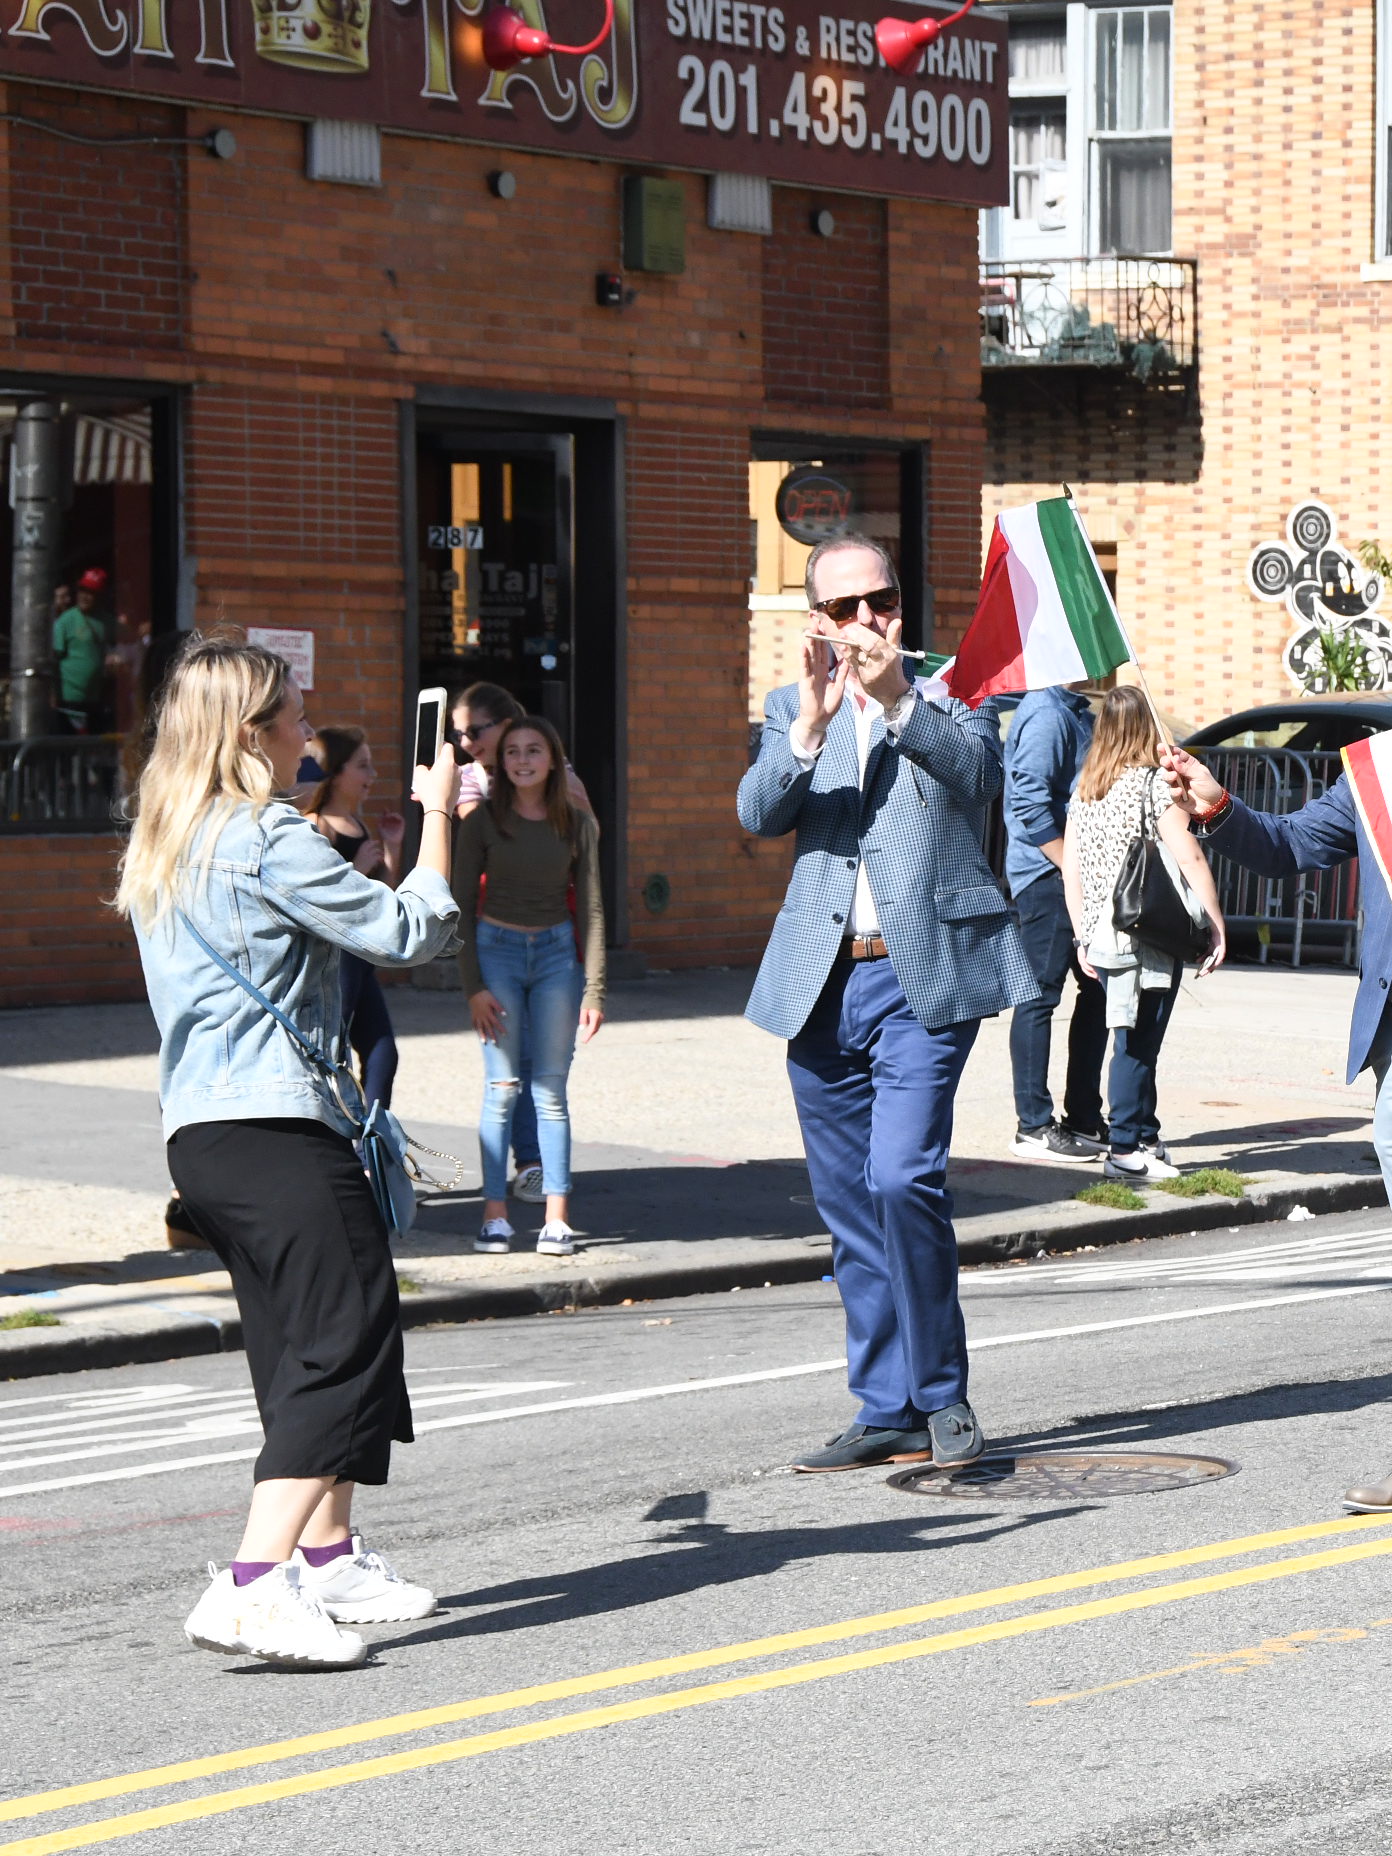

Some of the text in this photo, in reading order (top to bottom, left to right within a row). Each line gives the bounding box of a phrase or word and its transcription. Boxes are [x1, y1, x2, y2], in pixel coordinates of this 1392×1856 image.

[666, 0, 998, 83] SWEETS & RESRANT
[677, 54, 992, 166] 201.435.4900
[785, 489, 852, 523] OPEN
[431, 527, 480, 547] 287
